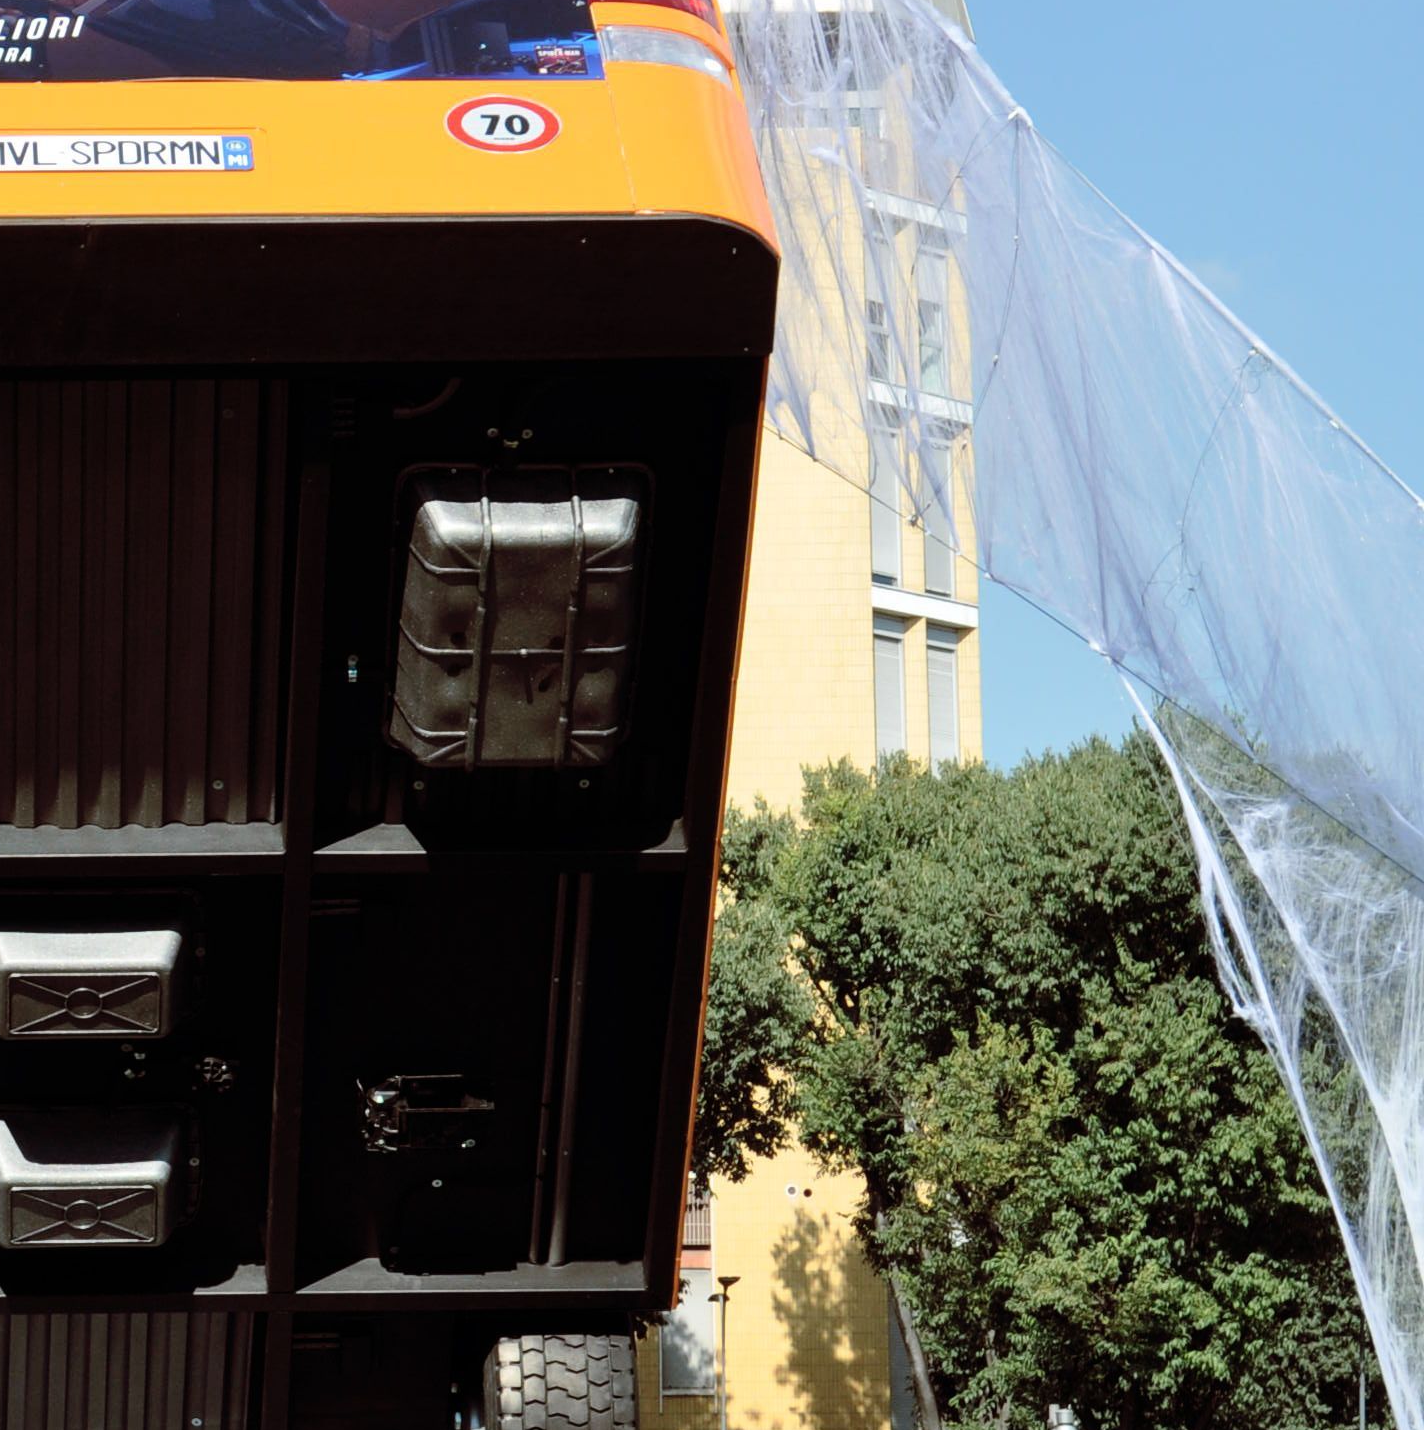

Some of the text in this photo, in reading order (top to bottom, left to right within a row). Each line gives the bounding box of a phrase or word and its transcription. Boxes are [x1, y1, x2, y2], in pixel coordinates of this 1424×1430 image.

[480, 114, 530, 136] 70
[70, 140, 221, 166] SPDRMN
[228, 154, 248, 167] MI
